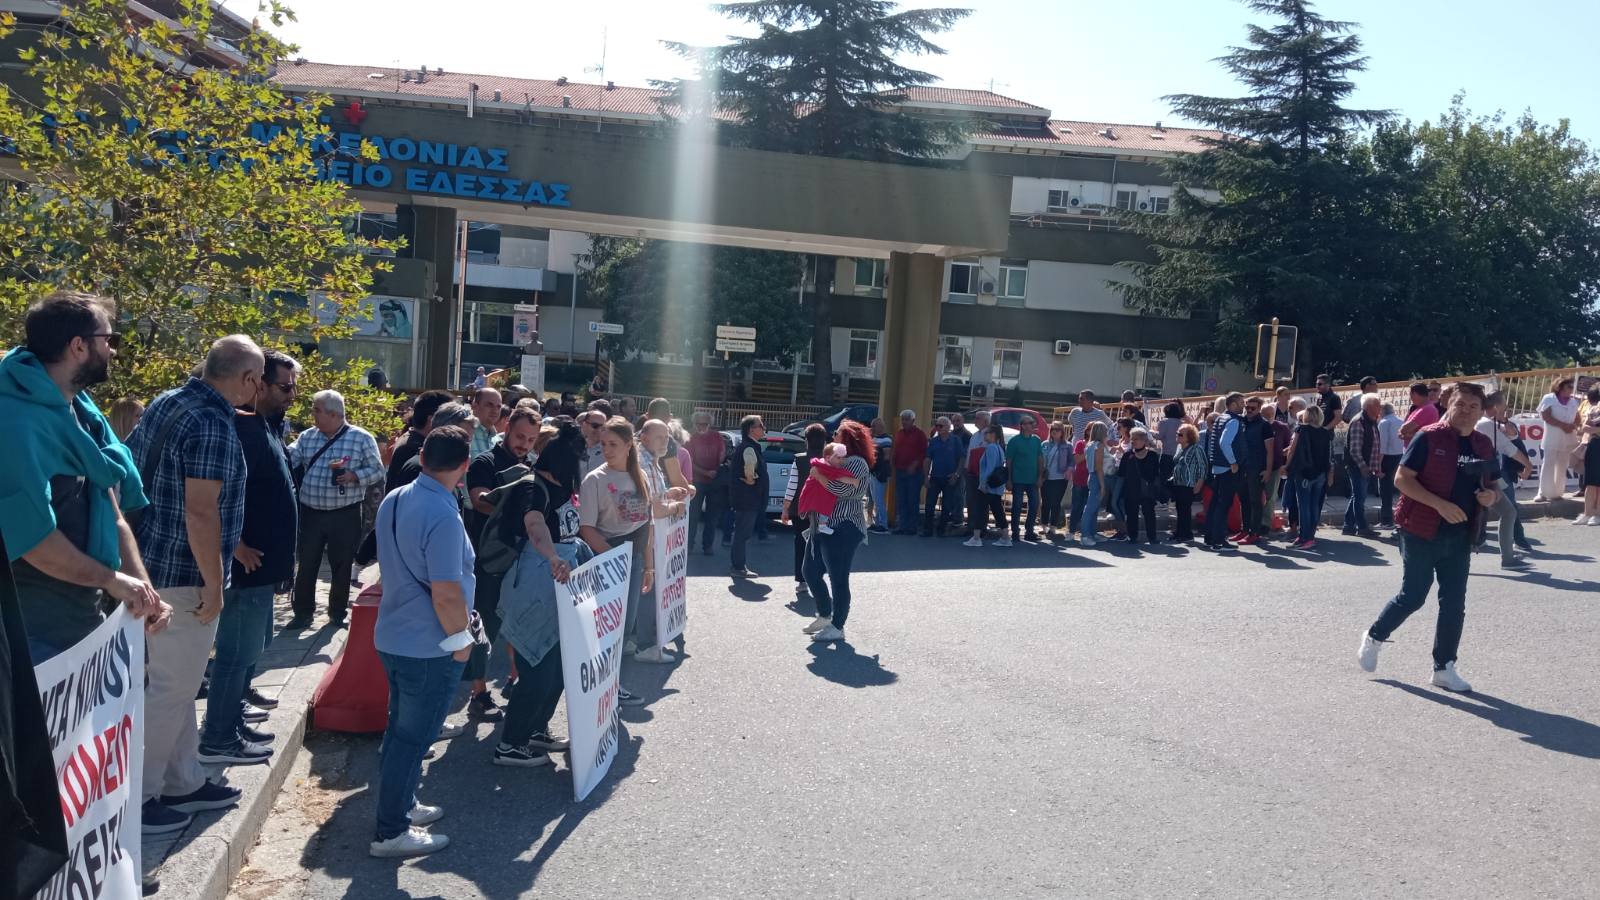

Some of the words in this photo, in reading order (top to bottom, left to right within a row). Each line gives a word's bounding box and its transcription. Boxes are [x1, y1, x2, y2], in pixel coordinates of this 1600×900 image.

[251, 123, 509, 172] ΜΚΕΟΝΙΑΣ
[406, 167, 571, 207] ΕΔΕΣΣΑΣ
[72, 627, 132, 733] ΝΟΜΟΥ
[581, 659, 596, 693] ΘΑ
